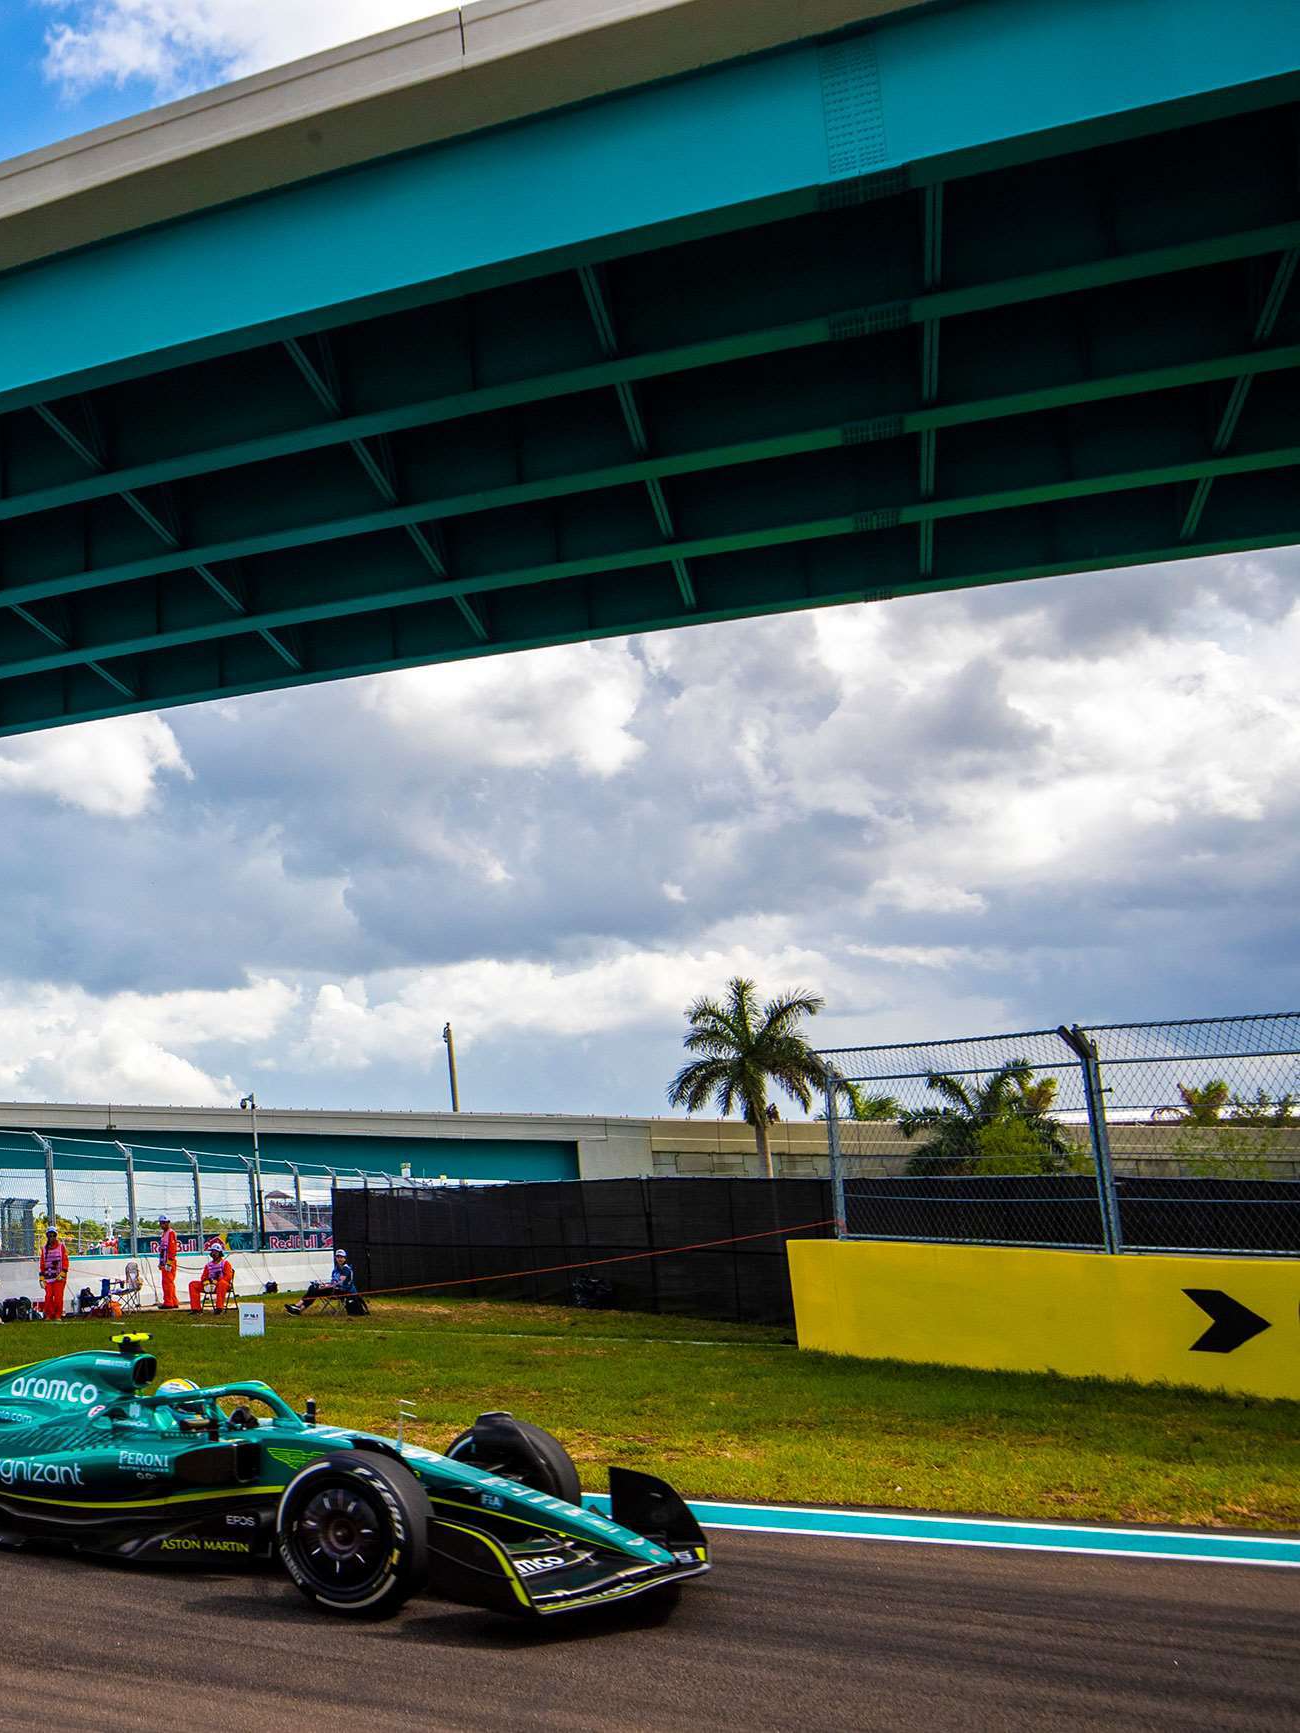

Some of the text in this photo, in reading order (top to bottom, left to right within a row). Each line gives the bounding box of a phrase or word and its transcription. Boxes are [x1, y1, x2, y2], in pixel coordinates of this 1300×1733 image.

[269, 1235, 294, 1249] Red
[11, 1377, 98, 1405] aramco
[119, 1450, 169, 1468] PERONI
[226, 1515, 255, 1527] EPOS
[160, 1539, 250, 1552] ASTON MARTIN
